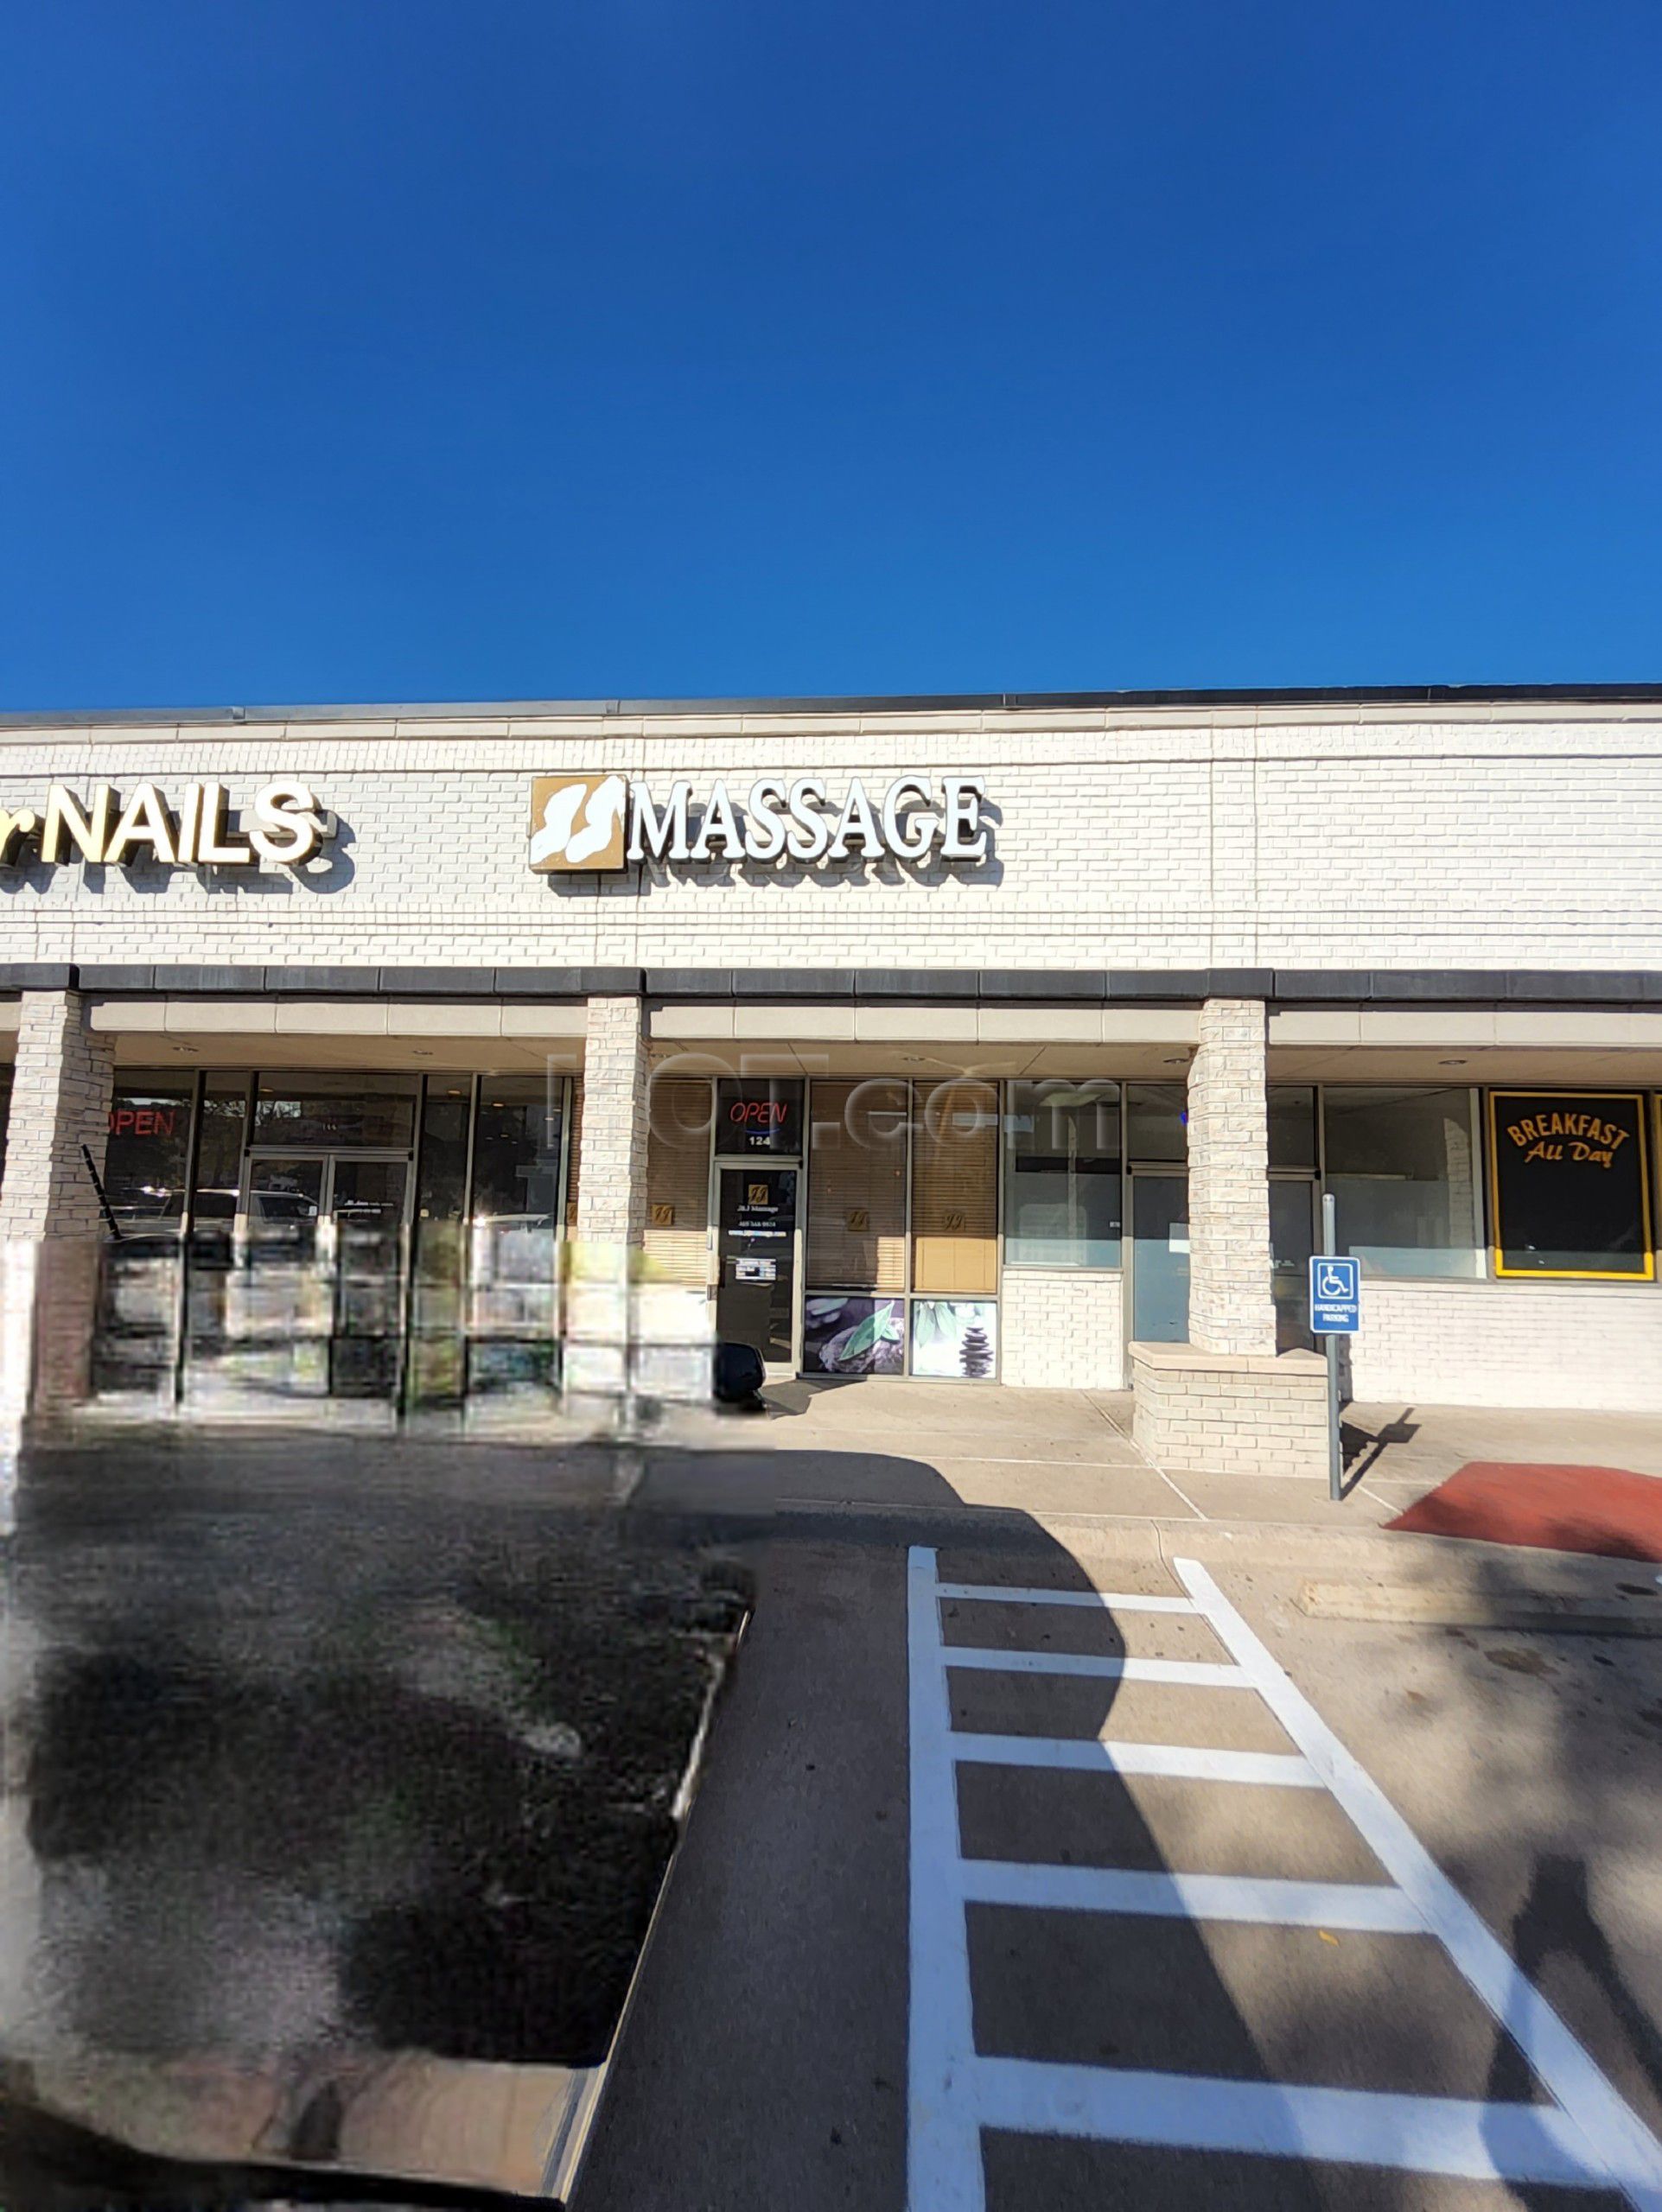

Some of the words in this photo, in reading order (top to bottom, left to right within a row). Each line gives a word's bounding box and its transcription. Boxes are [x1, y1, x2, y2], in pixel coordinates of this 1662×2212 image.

[41, 779, 316, 864] NAILS
[627, 775, 988, 861] MASSAGE
[730, 1102, 787, 1123] OPEN
[748, 1136, 772, 1146] 124
[1506, 1112, 1630, 1150] BREAKFAST
[1525, 1141, 1563, 1163] All
[1568, 1141, 1614, 1168] Day
